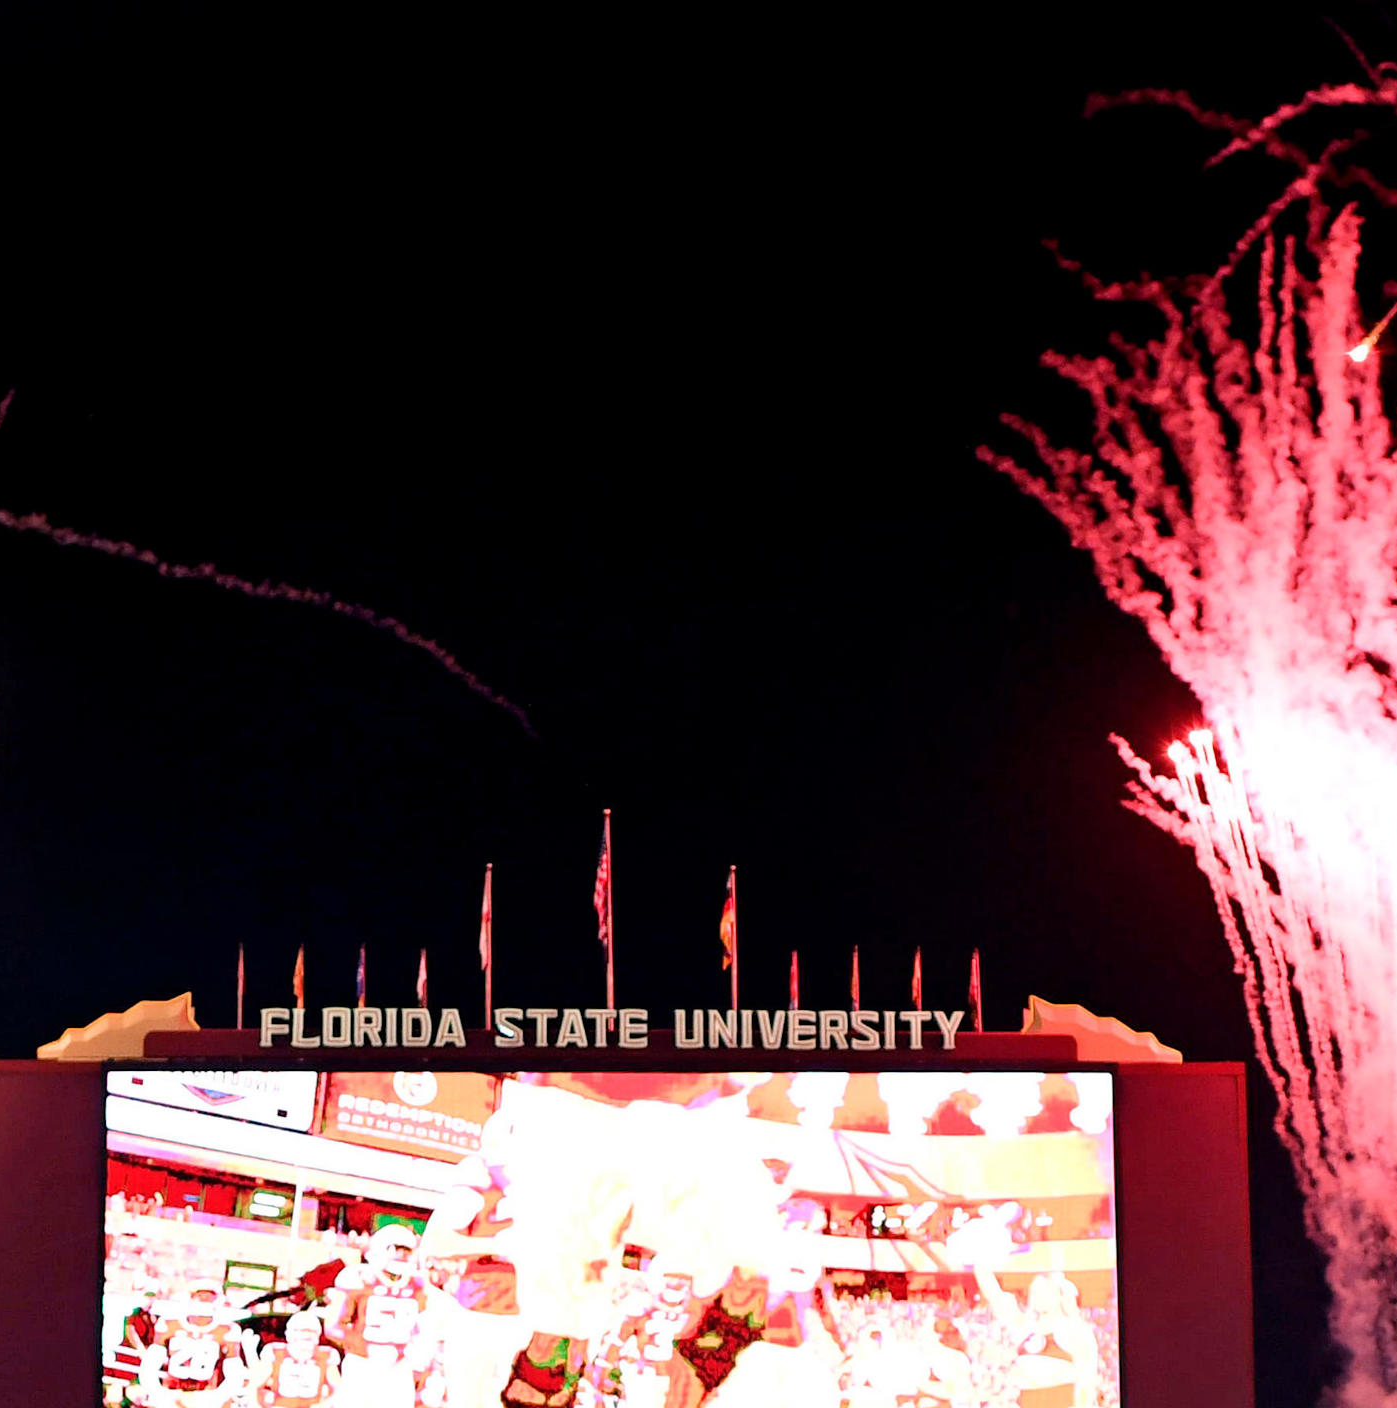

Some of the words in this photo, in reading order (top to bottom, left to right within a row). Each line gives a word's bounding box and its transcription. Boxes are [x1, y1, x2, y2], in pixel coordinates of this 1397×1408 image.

[259, 1007, 467, 1048] FLORIDA
[494, 1008, 648, 1048] STATE
[674, 1009, 965, 1050] UNIVERSITY
